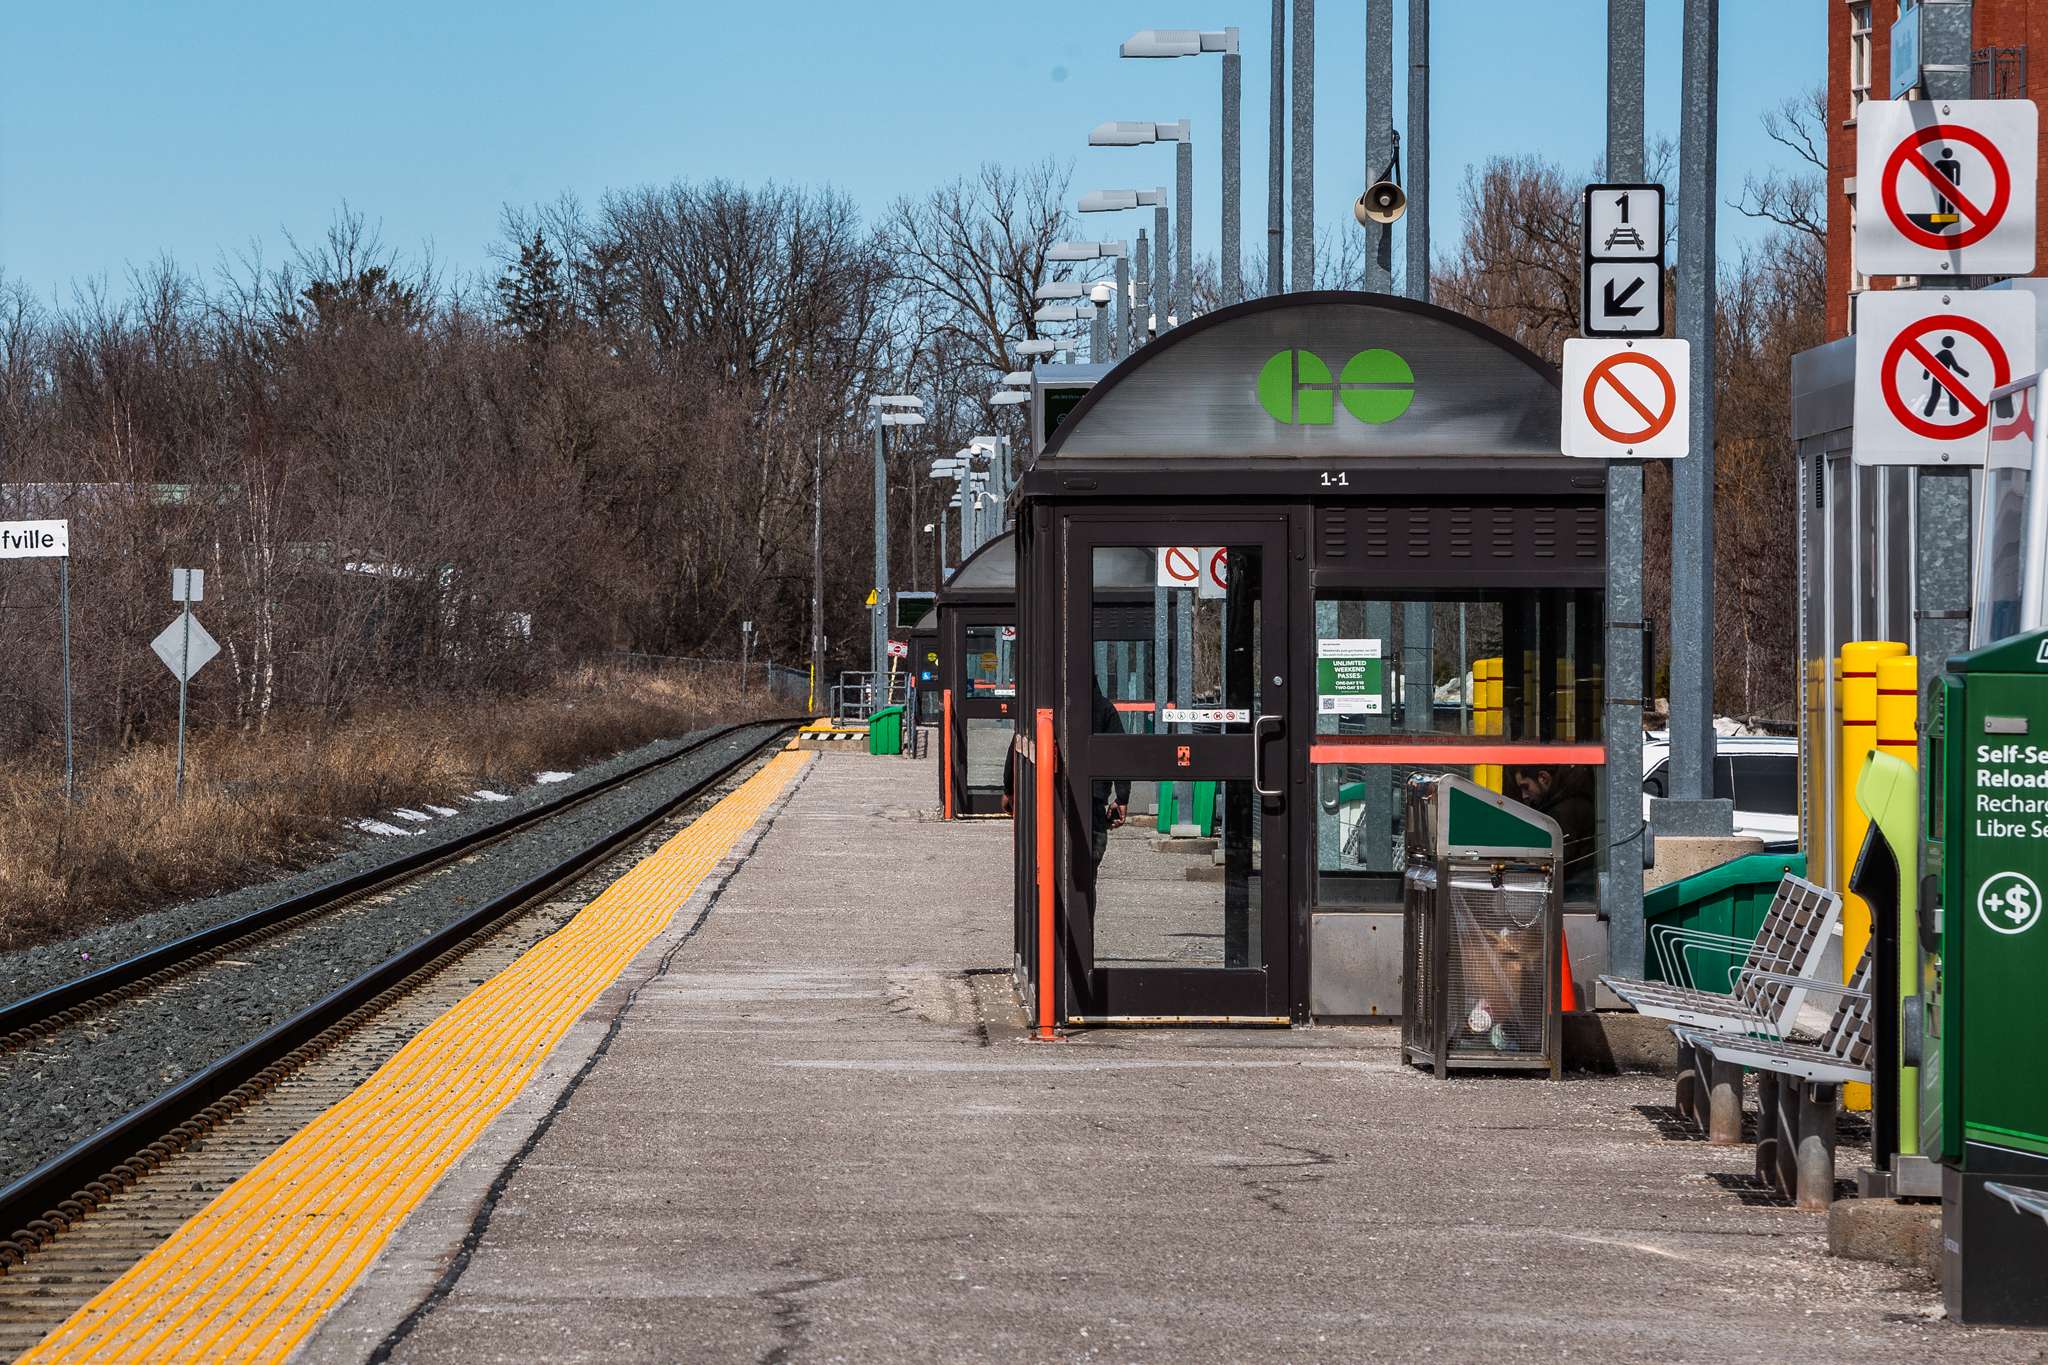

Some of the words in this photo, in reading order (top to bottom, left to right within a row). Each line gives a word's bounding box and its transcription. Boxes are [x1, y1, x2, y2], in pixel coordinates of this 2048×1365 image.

[1615, 195, 1629, 224] 1
[1257, 348, 1415, 424] GO
[1320, 472, 1349, 486] 1-1
[1, 529, 54, 549] fville
[1976, 744, 2048, 764] Self-Se
[1976, 768, 2048, 788] Reload
[1976, 818, 2026, 838] Libre
